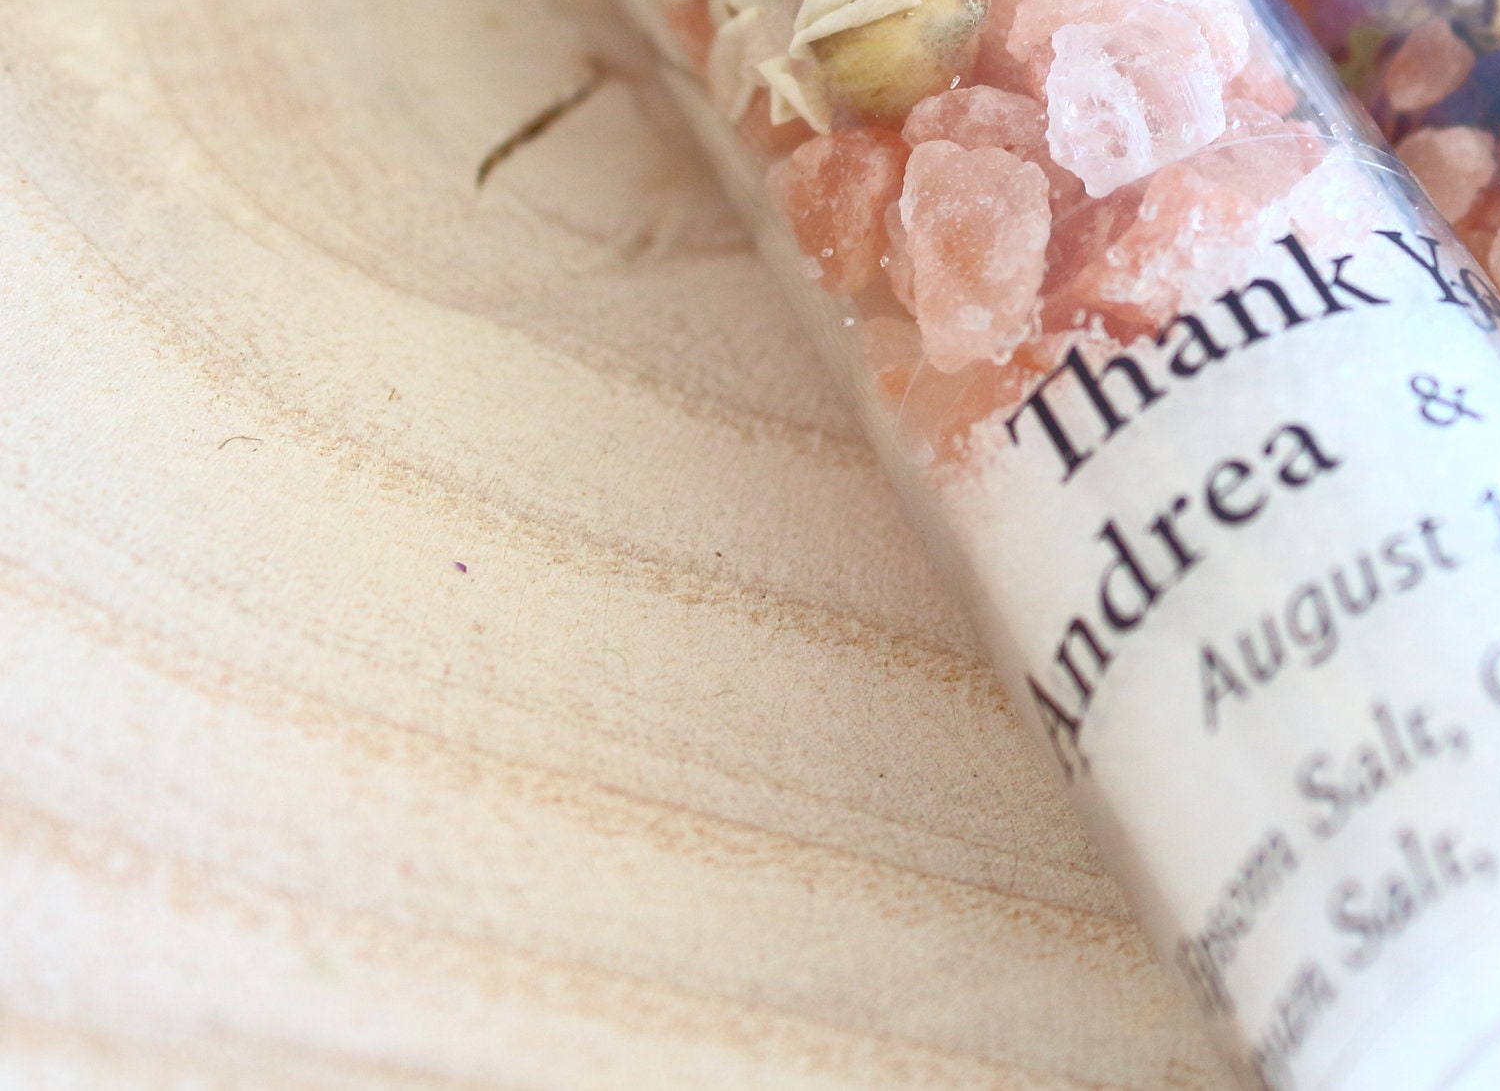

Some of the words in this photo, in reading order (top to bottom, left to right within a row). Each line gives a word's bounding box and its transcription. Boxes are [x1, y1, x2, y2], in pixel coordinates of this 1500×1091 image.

[1003, 232, 1392, 486] Thank
[1023, 419, 1344, 786] Andrea
[1408, 372, 1485, 428] &
[1198, 514, 1462, 734] August
[1294, 702, 1470, 840] Salt,
[1325, 822, 1500, 972] Salt,
